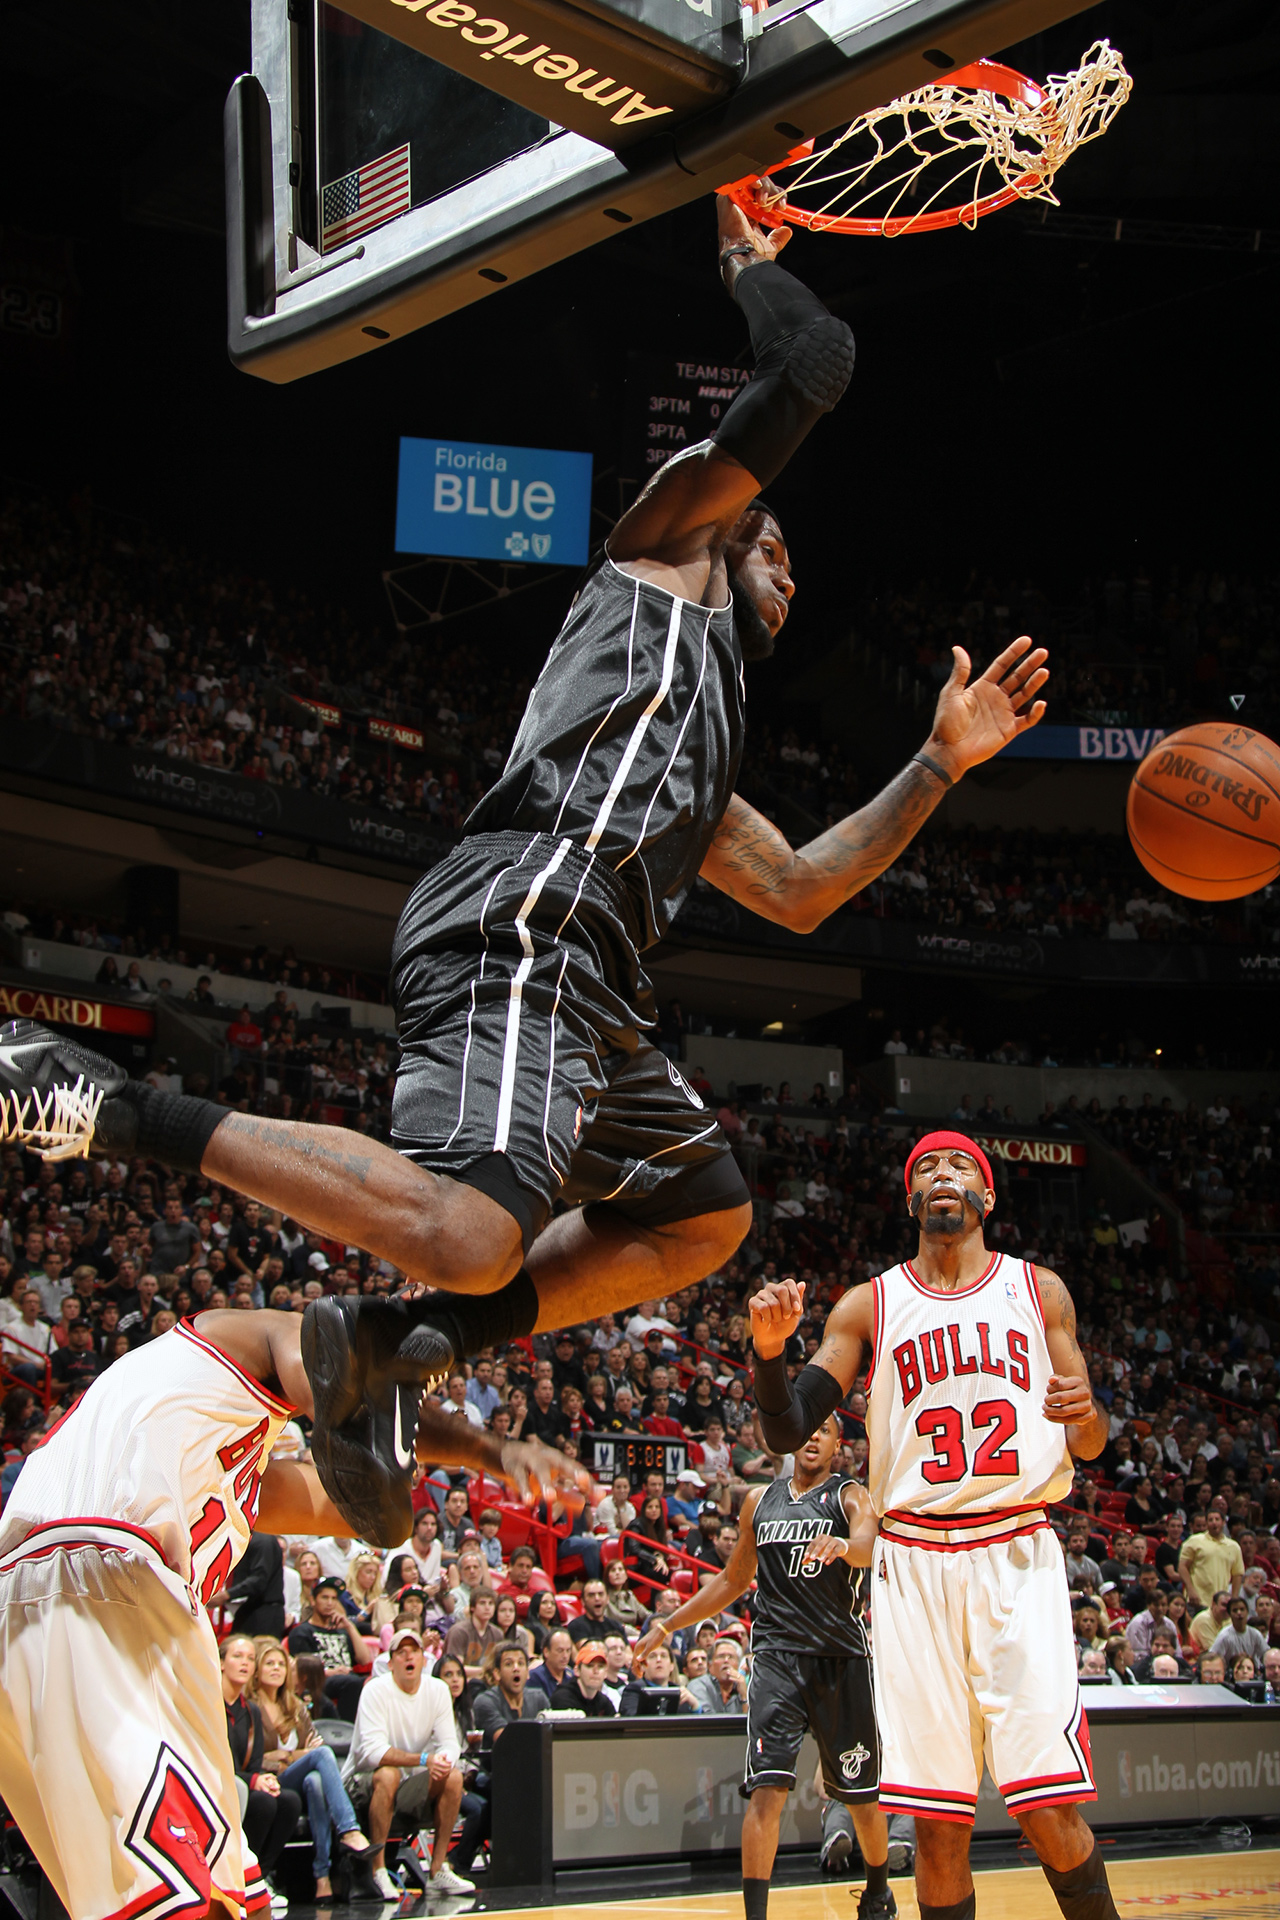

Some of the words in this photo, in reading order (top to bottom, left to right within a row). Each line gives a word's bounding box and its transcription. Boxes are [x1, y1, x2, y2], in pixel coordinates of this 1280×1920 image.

[676, 362, 719, 380] TEAM
[698, 386, 740, 400] HEAT
[649, 396, 691, 415] 3PTM
[711, 403, 720, 418] 0
[648, 423, 687, 440] 3PTA
[435, 447, 507, 472] Florida
[1153, 751, 1270, 821] SPALDING
[893, 1322, 1031, 1409] BULLS
[914, 1398, 1020, 1485] 32
[627, 1444, 665, 1468] 5:02
[757, 1519, 833, 1546] MIAMI
